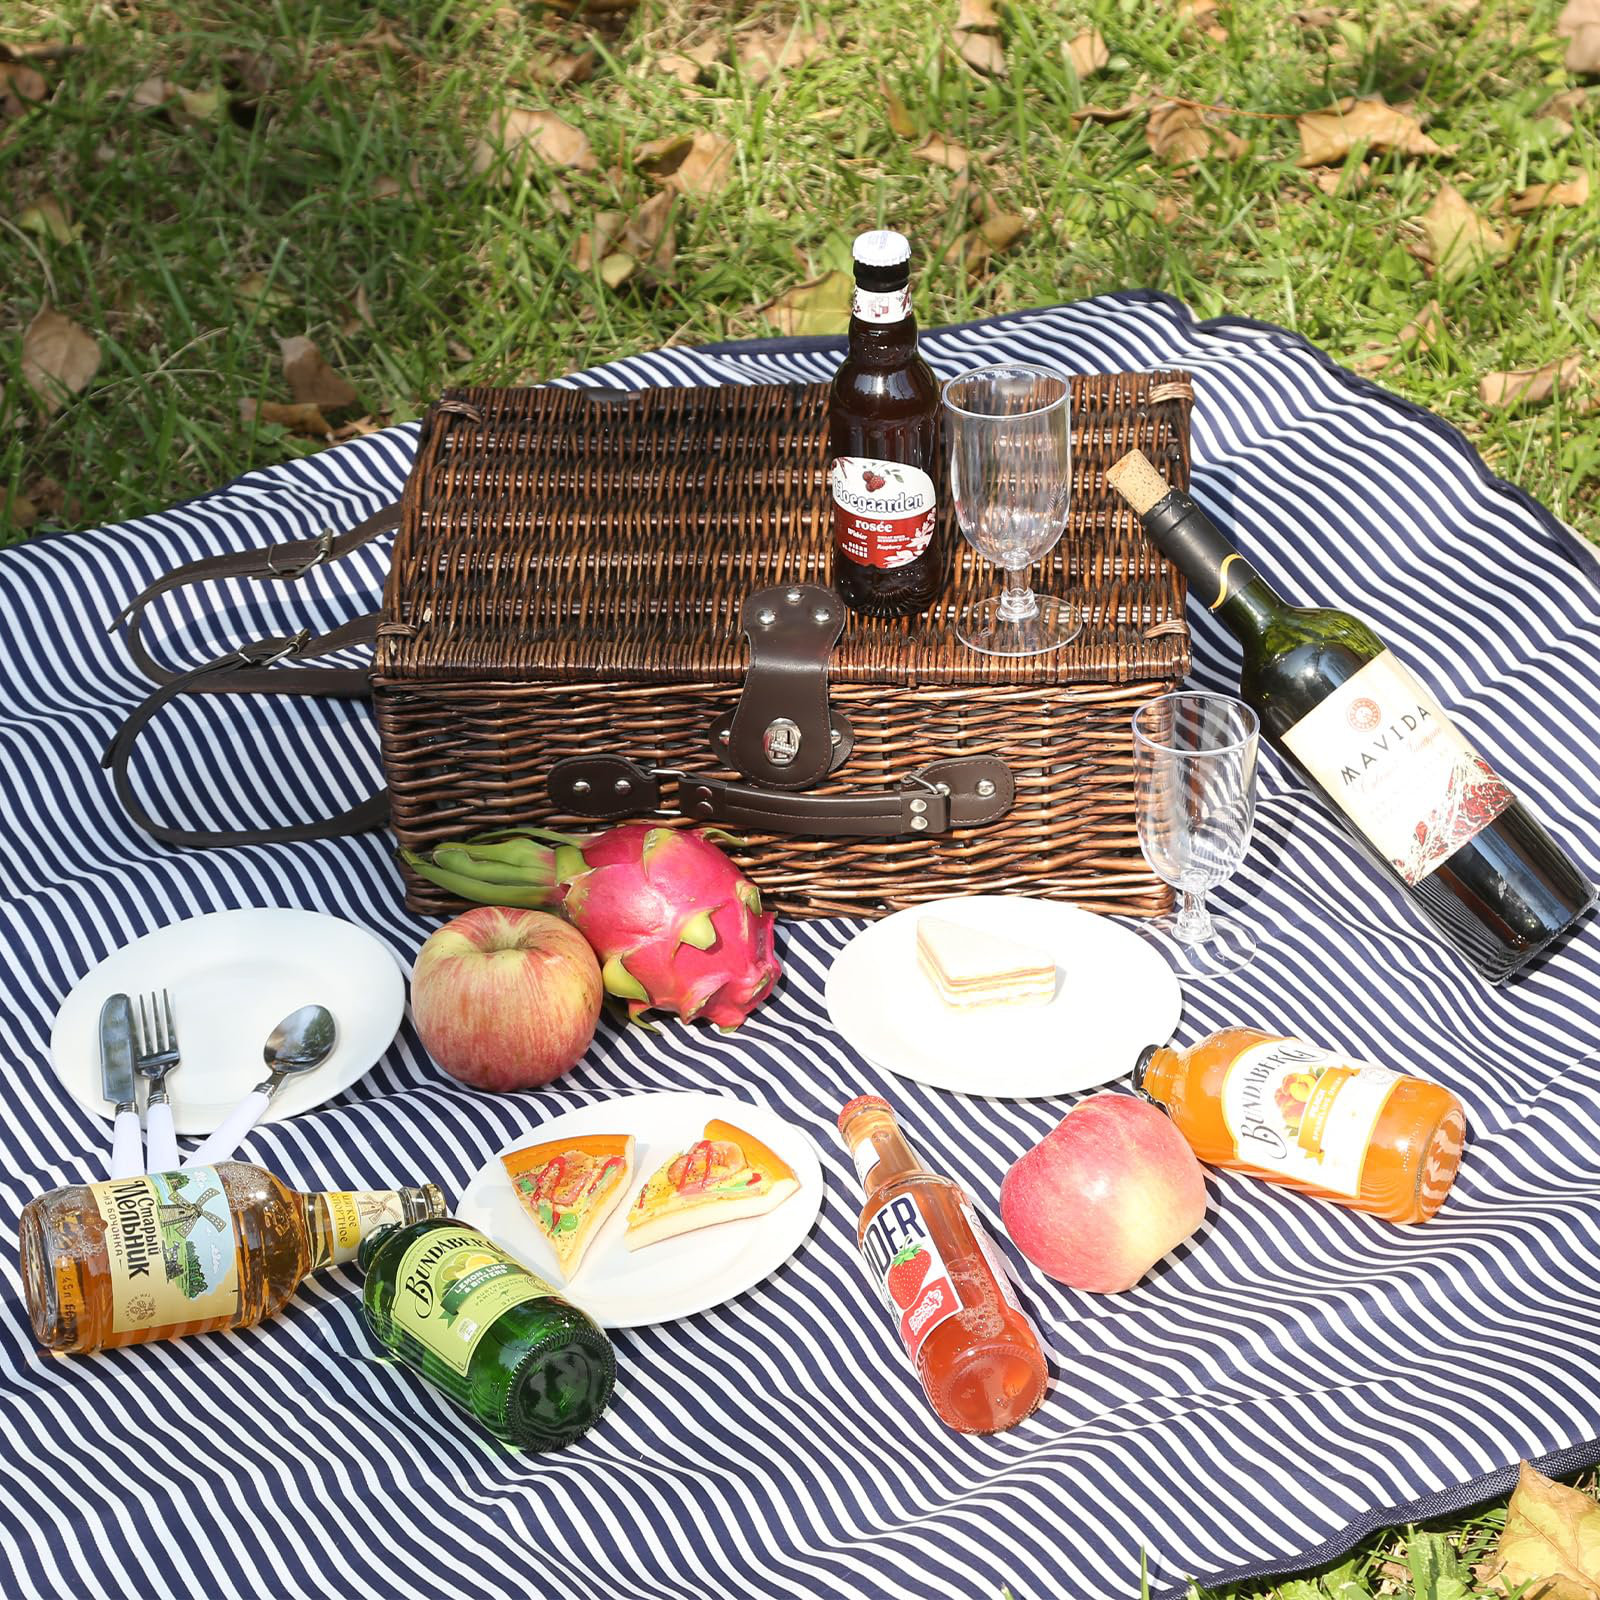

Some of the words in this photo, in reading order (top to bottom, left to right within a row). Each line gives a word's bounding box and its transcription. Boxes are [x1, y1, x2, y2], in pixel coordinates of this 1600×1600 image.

[855, 519, 893, 533] rosée
[1341, 705, 1432, 786] MAVIDA
[1240, 1045, 1329, 1160] BUNDABERG
[109, 1181, 149, 1280] Мельник
[138, 1198, 160, 1255] Старый
[861, 1197, 927, 1284] IDER
